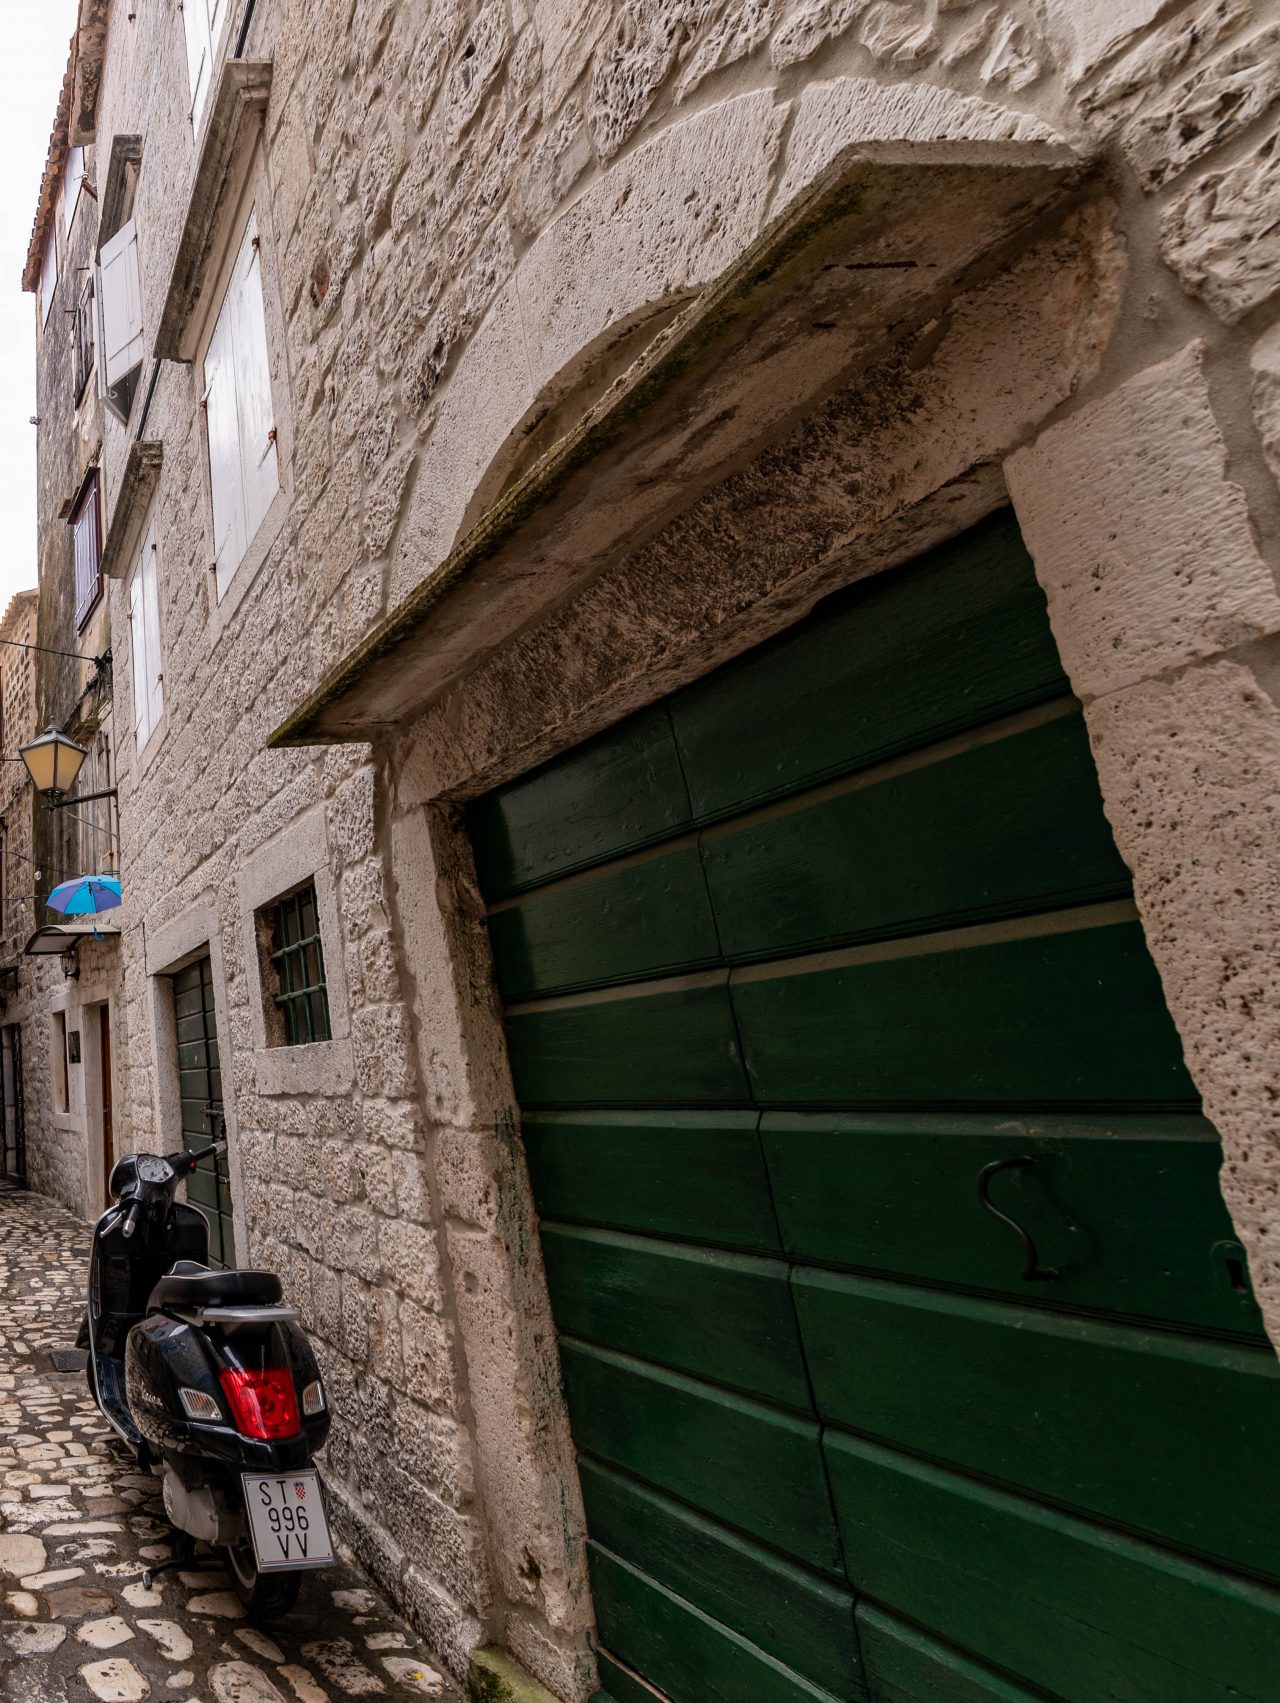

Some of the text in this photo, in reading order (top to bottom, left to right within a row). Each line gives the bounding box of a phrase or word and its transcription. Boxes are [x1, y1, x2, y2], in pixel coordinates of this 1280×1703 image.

[259, 1480, 287, 1506] ST
[268, 1505, 309, 1533] 996
[276, 1532, 308, 1560] VV
